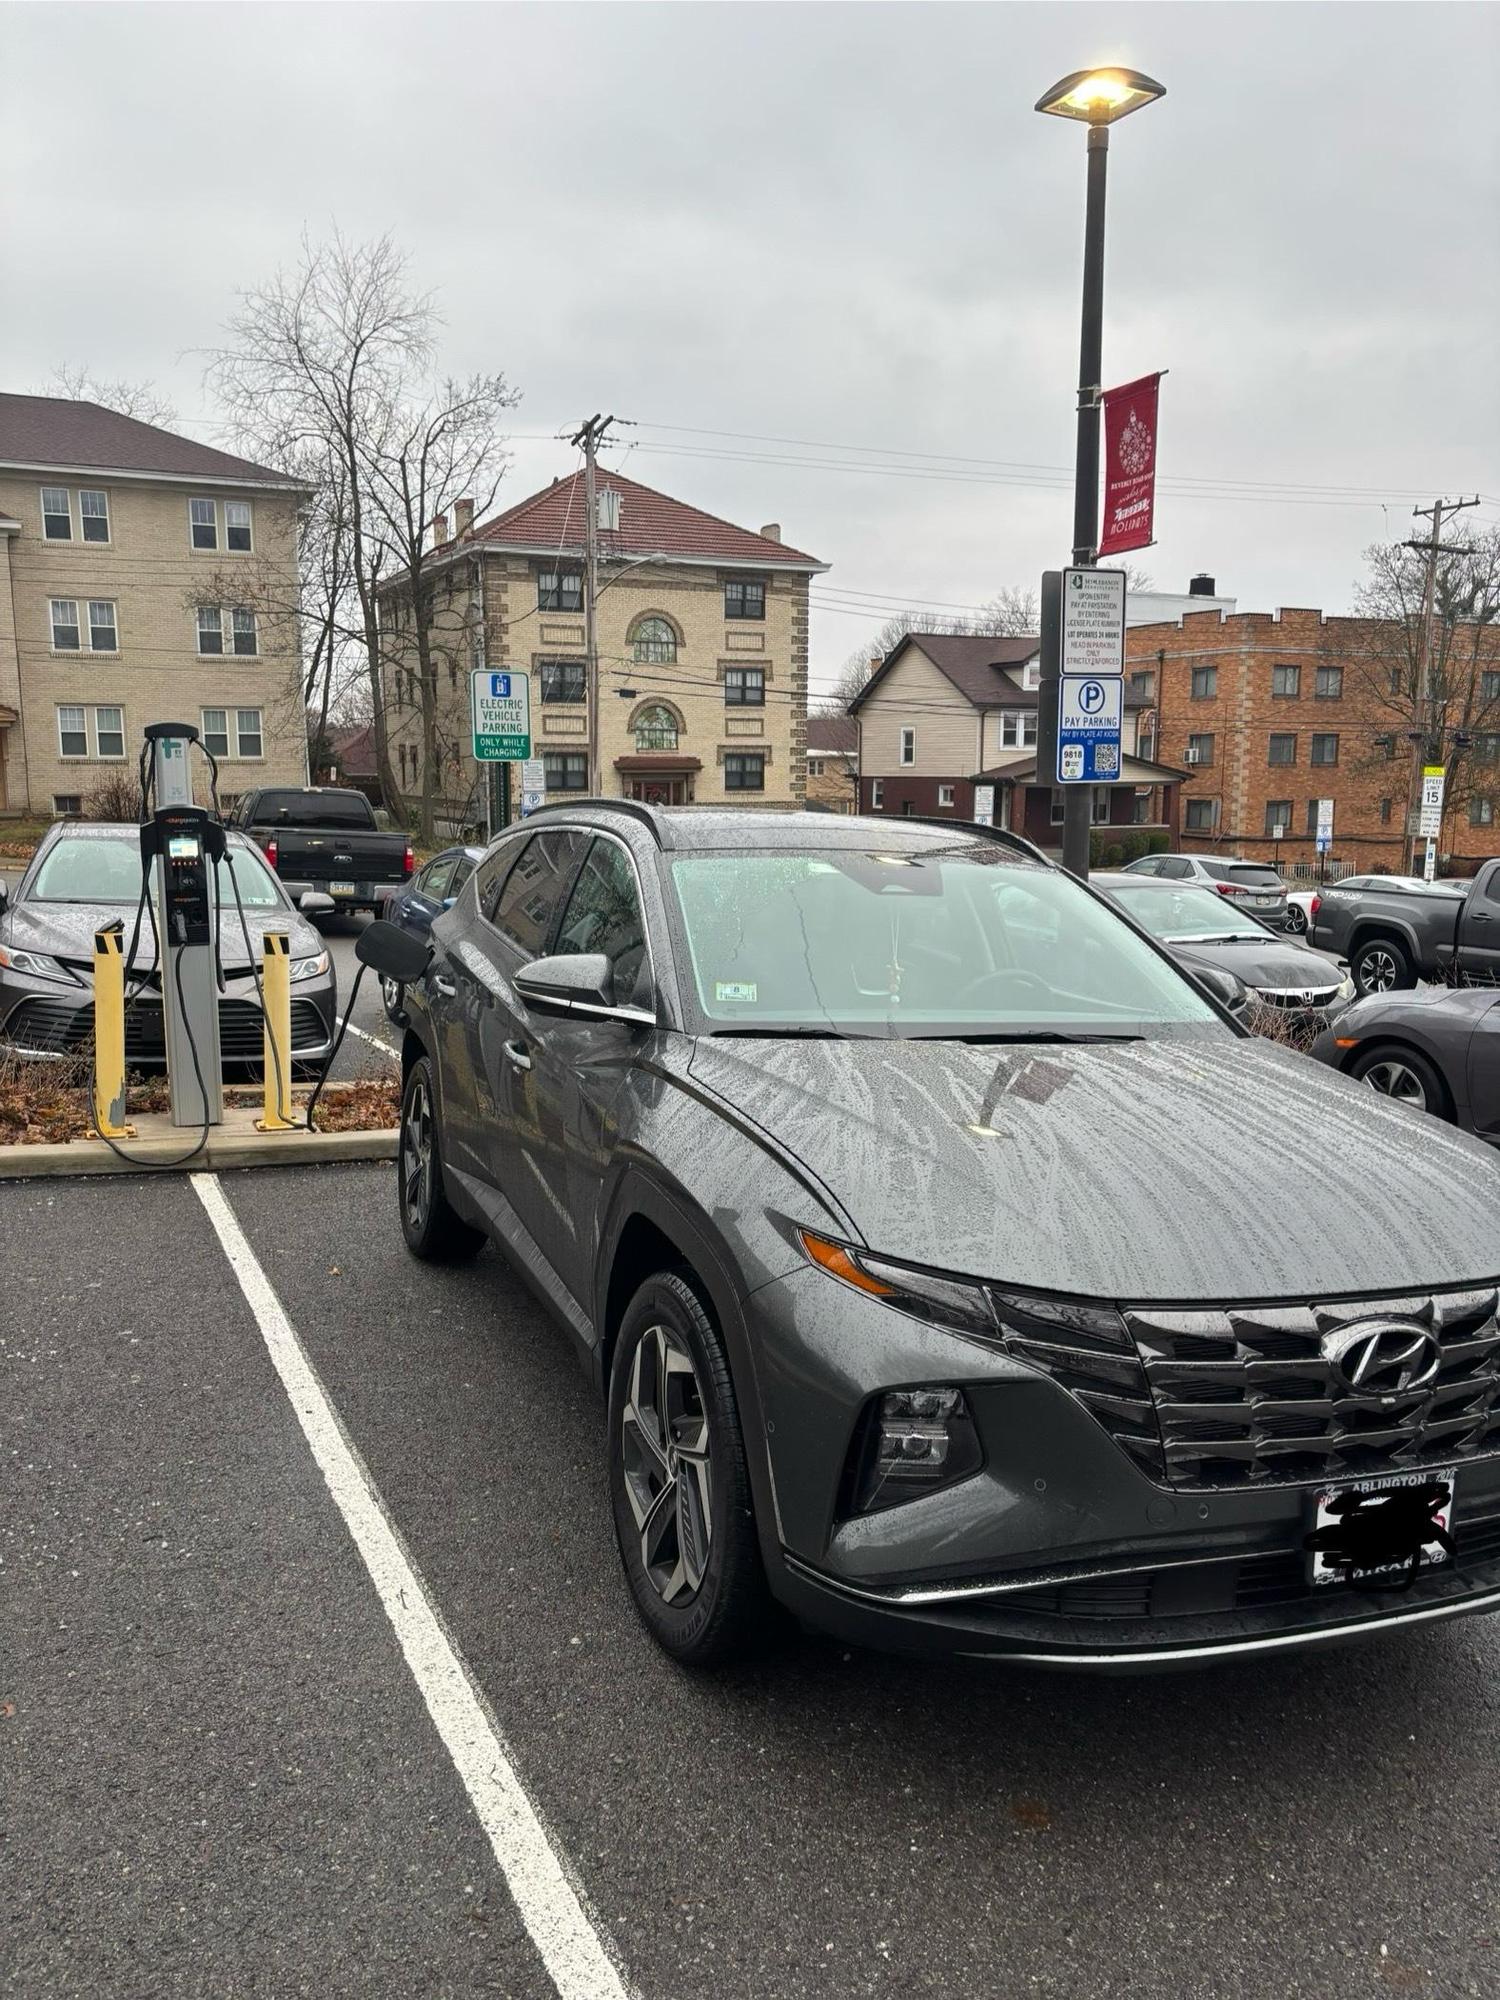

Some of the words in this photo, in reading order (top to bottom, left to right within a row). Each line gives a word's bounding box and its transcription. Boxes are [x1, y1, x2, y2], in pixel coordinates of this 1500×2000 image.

[1085, 686, 1100, 709] P
[480, 699, 523, 710] ELECTRIC
[483, 711, 521, 721] VEHICLE
[1065, 717, 1080, 727] PAY
[1083, 717, 1118, 727] PARKING
[482, 723, 523, 733] PARKING
[480, 738, 500, 746] ONLY
[502, 738, 526, 747] WHILE
[484, 748, 523, 757] CHARGING
[1064, 751, 1082, 759] 9818
[1427, 792, 1439, 803] 15
[1352, 1474, 1427, 1493] ARLINGTON
